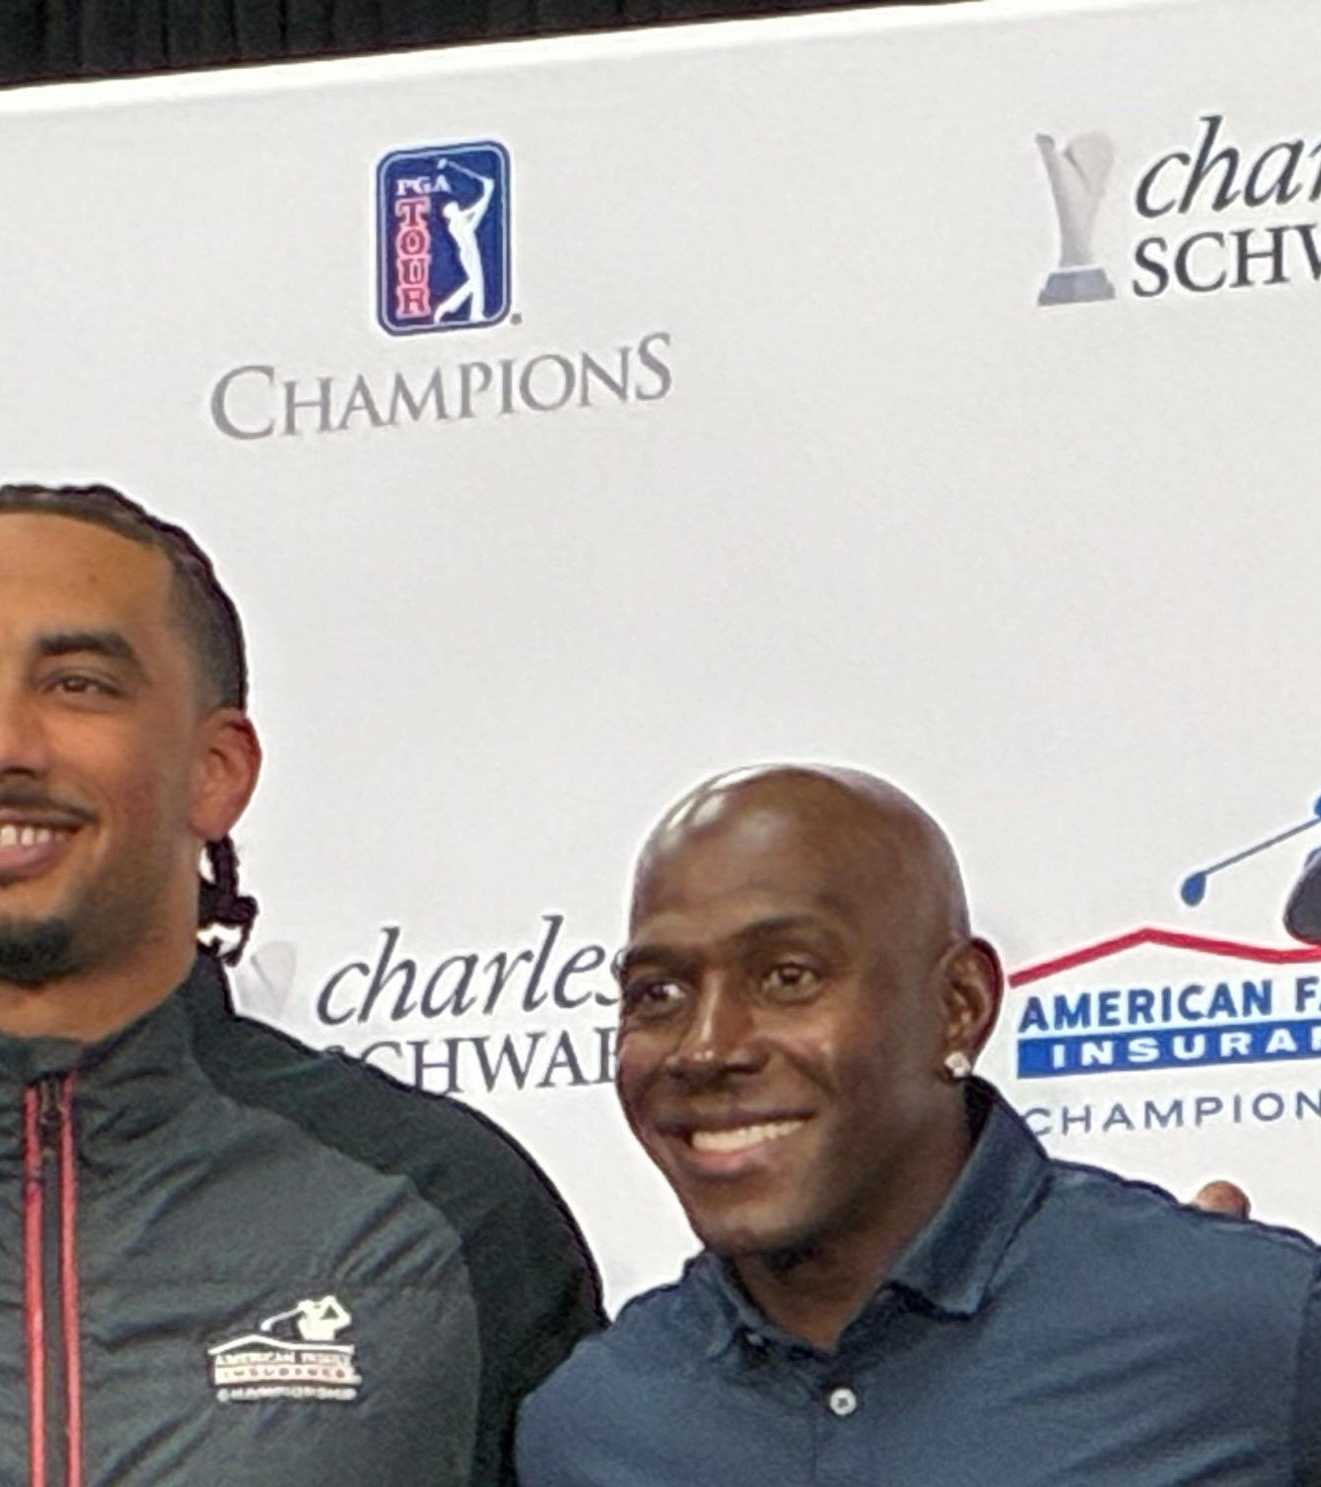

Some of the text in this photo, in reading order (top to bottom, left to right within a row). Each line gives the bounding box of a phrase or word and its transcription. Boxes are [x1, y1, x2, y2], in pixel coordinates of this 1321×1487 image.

[395, 174, 453, 196] PGA
[395, 196, 431, 320] TOUR
[210, 332, 673, 440] CHAMPIONS
[1018, 979, 1273, 1034] AMERICAN
